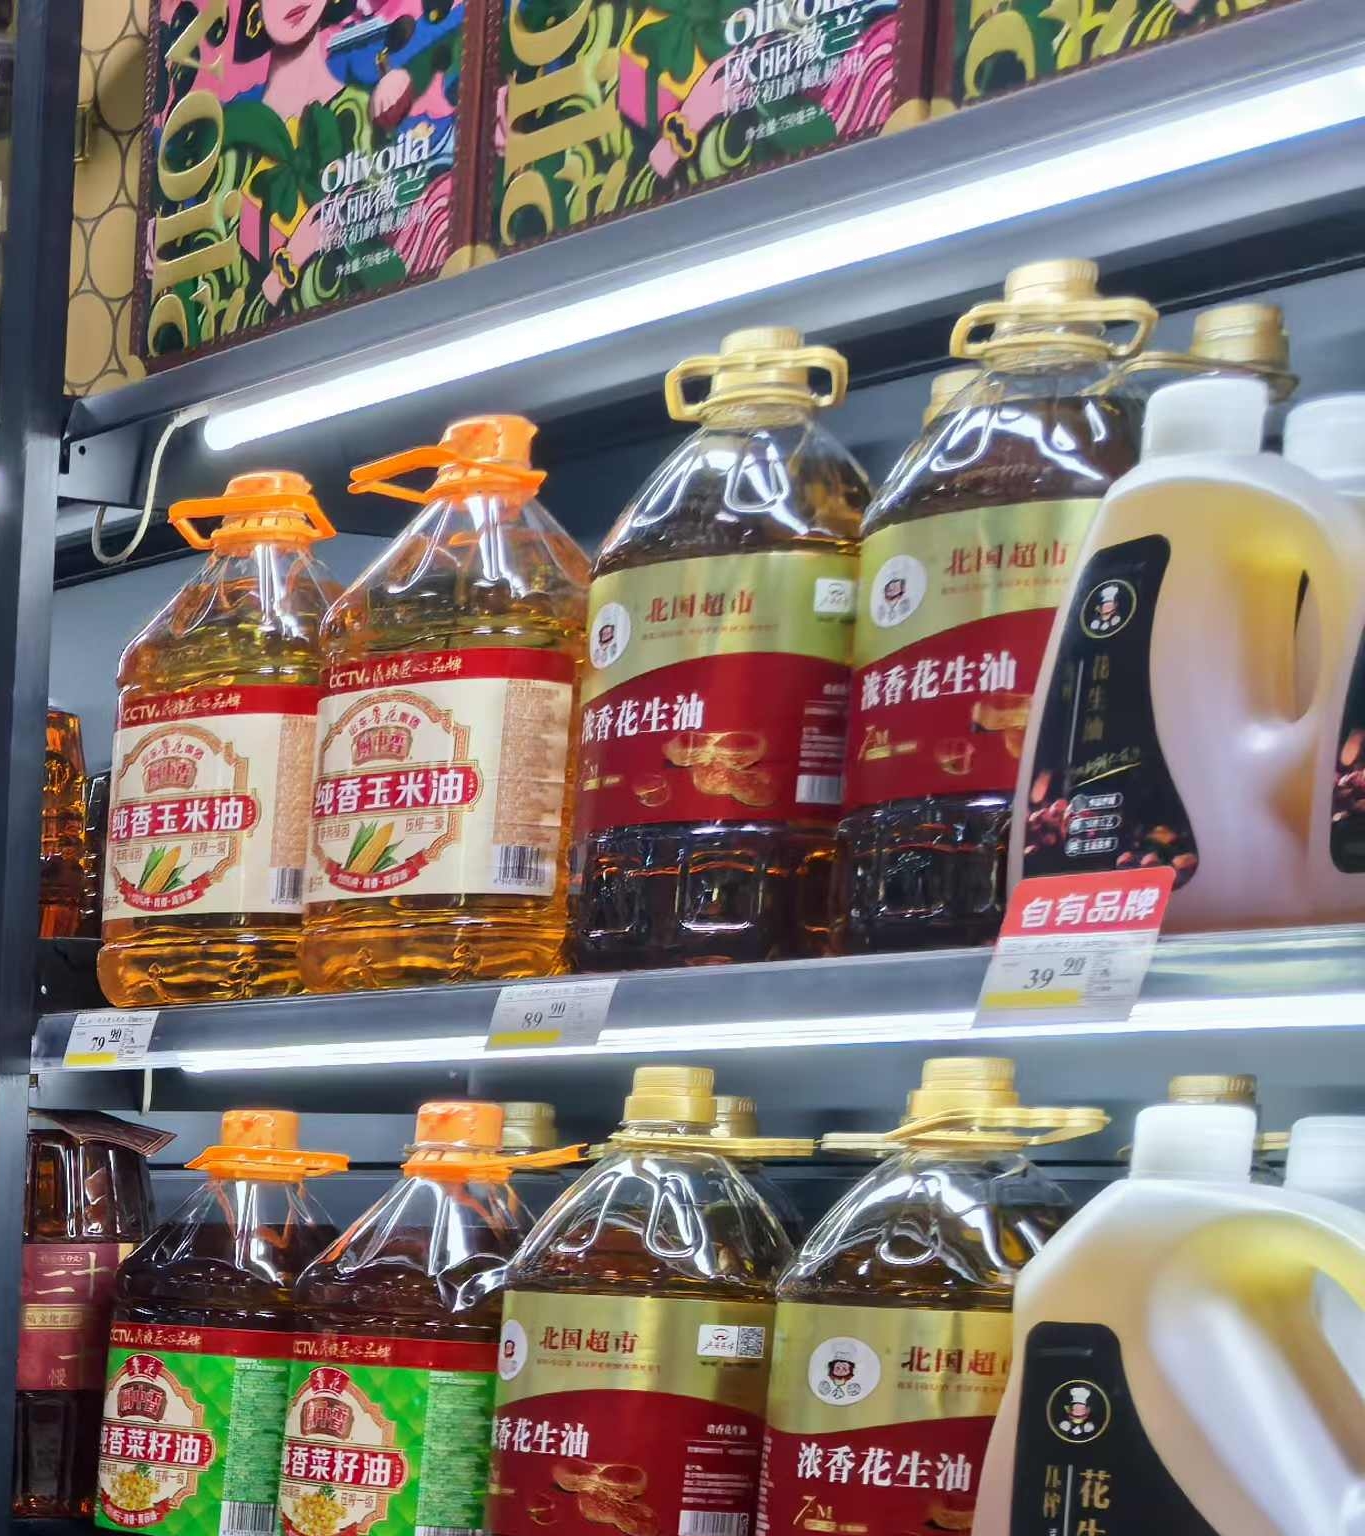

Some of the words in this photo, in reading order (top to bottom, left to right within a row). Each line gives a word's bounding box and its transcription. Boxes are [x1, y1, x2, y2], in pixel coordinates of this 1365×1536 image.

[723, 13, 864, 88] 欧丽薇兰
[320, 131, 432, 195] Olivoila
[946, 540, 1066, 576] 北国超市
[645, 589, 756, 624] 北国超市
[861, 651, 1017, 712] 浓香花生油
[582, 690, 705, 745] 浓香花生油
[315, 769, 464, 815] 纯香玉米油
[111, 797, 245, 839] 纯香玉米油
[1020, 886, 1161, 931] 自有品牌
[1023, 966, 1055, 992] 39
[91, 1035, 106, 1051] 79
[539, 1326, 638, 1354] 北国超市
[901, 1345, 1007, 1376] 北国超
[796, 1441, 973, 1492] 浓香花生油
